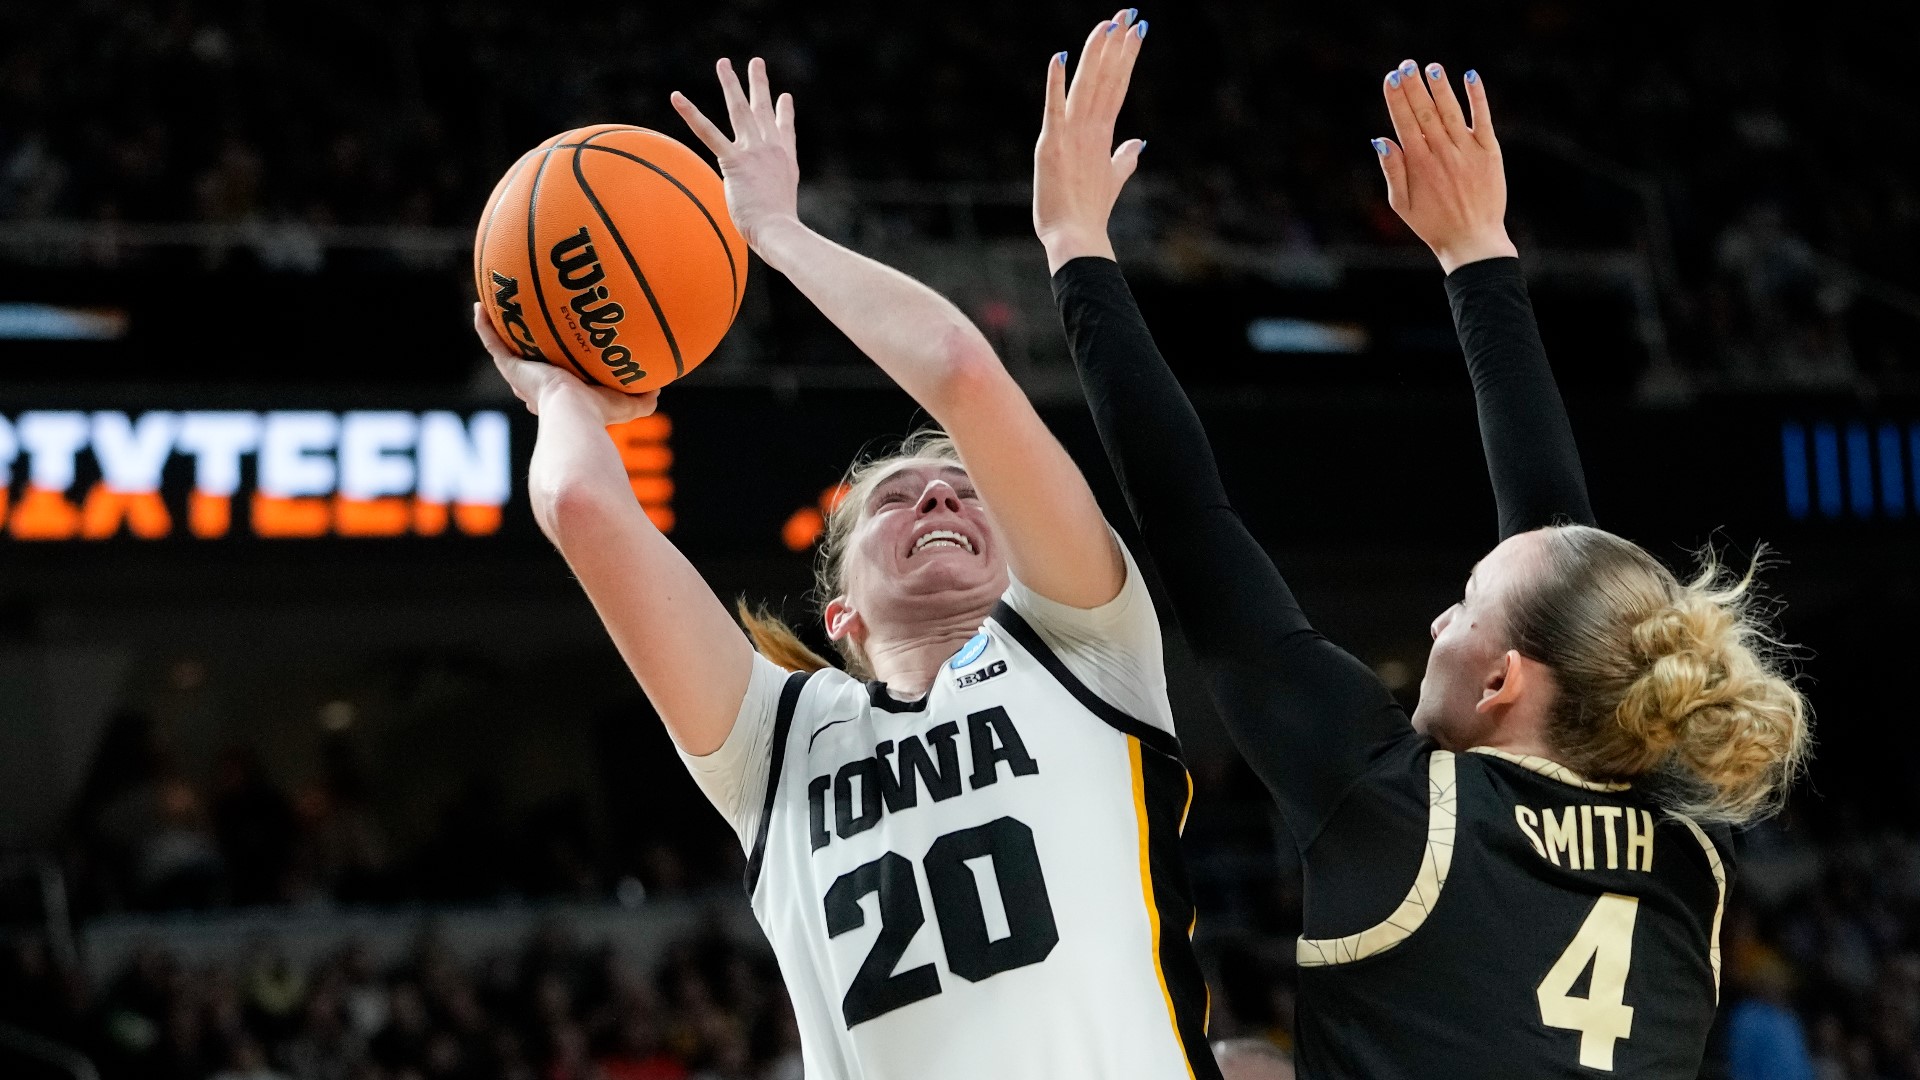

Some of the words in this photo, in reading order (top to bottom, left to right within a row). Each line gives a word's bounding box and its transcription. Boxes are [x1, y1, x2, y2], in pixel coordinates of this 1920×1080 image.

[550, 225, 647, 386] Wilson
[560, 305, 577, 330] EVO
[574, 332, 592, 354] NXT
[0, 410, 510, 539] IXTEEN
[808, 705, 1040, 857] IOWA
[1514, 804, 1655, 873] SMITH
[823, 815, 1060, 1031] 20
[1536, 892, 1640, 1072] 4
